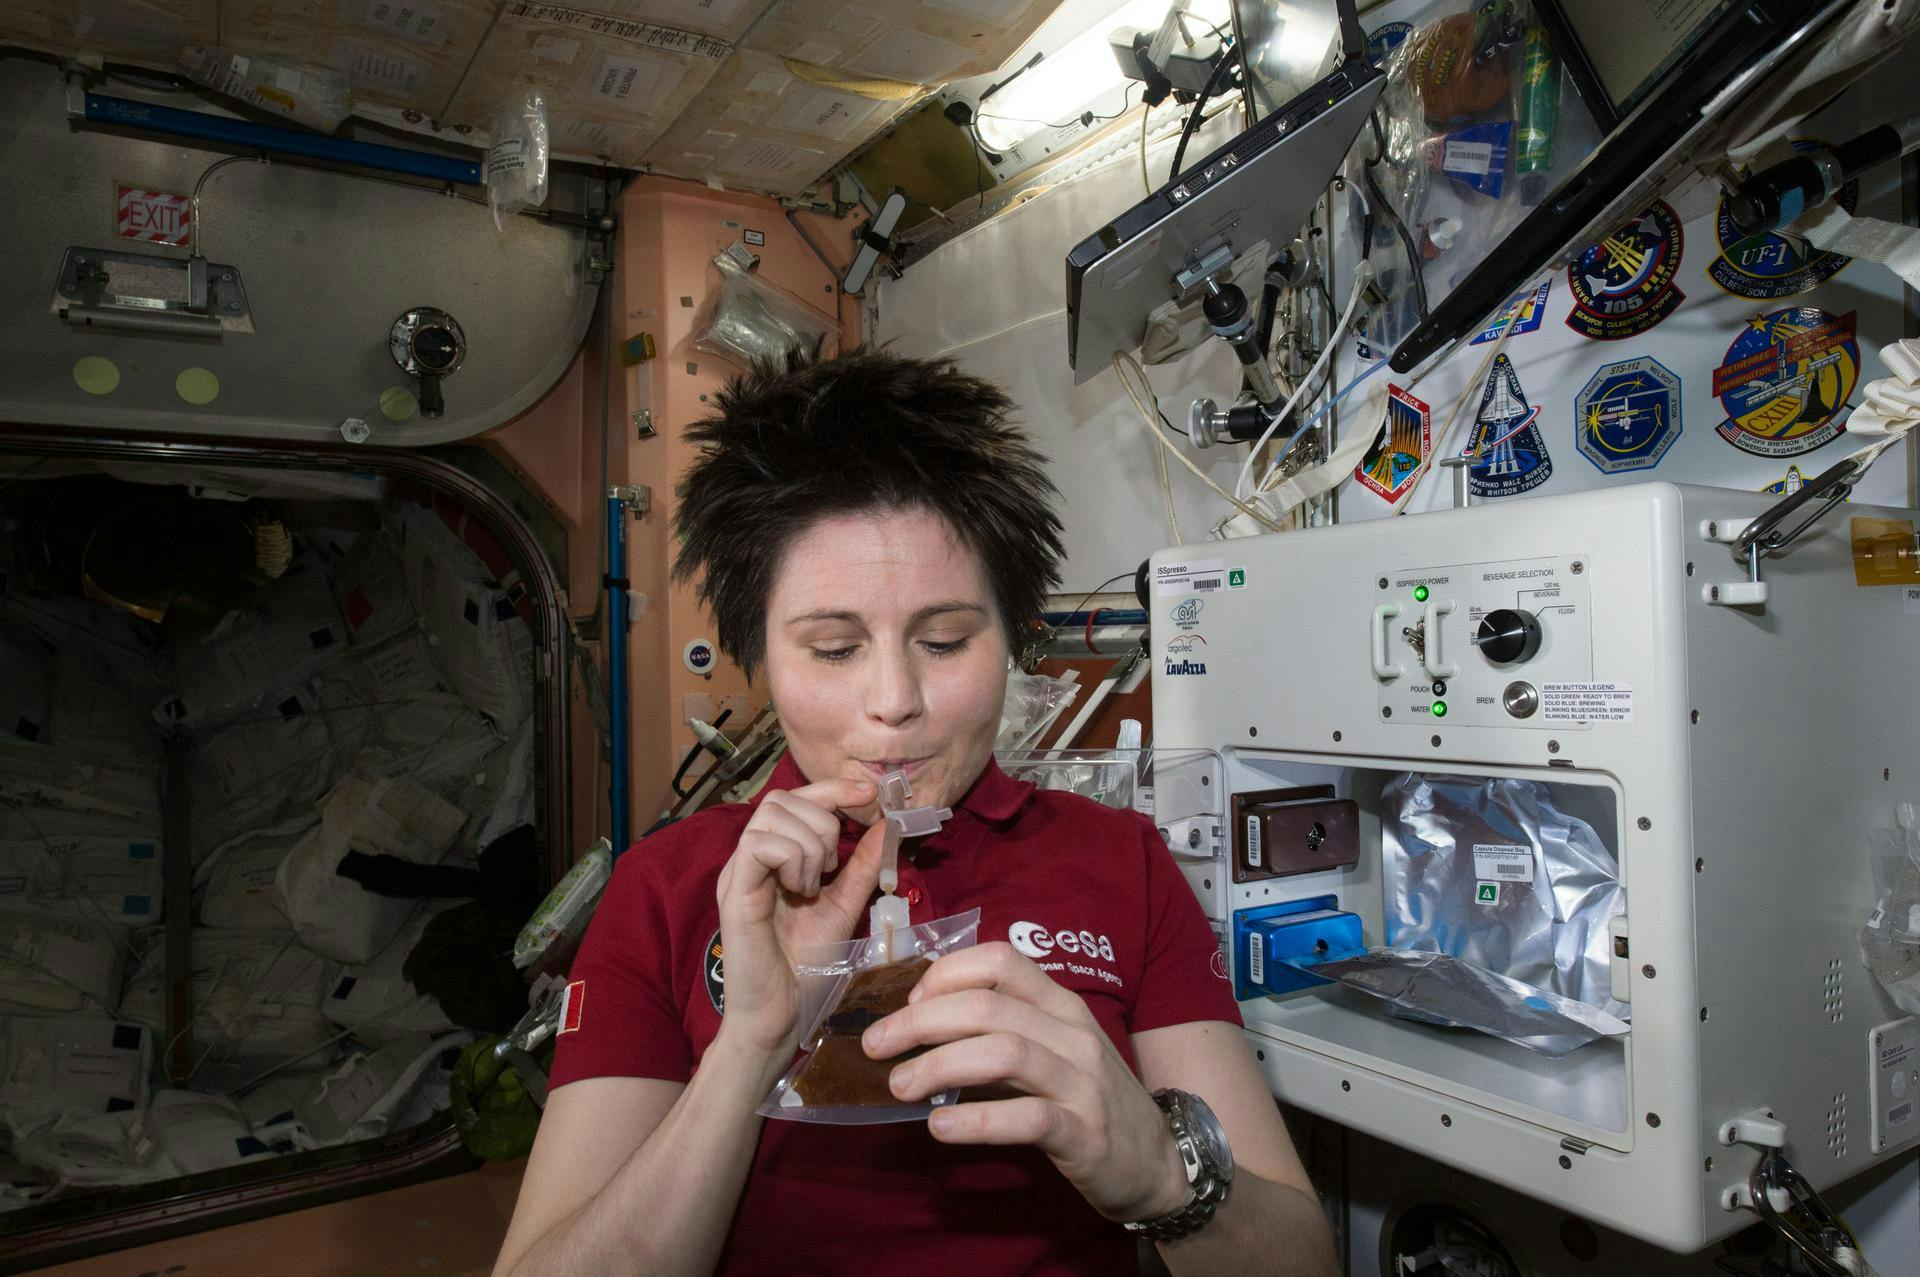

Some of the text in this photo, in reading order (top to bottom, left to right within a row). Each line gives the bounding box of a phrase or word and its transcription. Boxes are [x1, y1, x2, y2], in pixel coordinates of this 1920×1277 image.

[1368, 24, 1405, 43] TURCKOW
[130, 200, 178, 232] EXIT
[1659, 223, 1679, 286] FORRESTER
[1741, 242, 1788, 267] UF-1
[1536, 282, 1550, 305] REIL
[1572, 275, 1590, 303] BARRY
[1714, 270, 1768, 298] CULBERTSON
[1603, 295, 1645, 314] 105
[1610, 361, 1641, 375] STS-112
[1720, 350, 1771, 376] WETHERBEE
[1484, 364, 1500, 401] COCKRELL
[1503, 361, 1522, 396] LOCKHART
[1649, 366, 1674, 386] MELROY
[1719, 365, 1772, 391] HERRINGTON
[1584, 376, 1604, 398] ASHBY
[1399, 391, 1420, 409] FRICK
[1670, 398, 1679, 420] WOLF
[1468, 423, 1481, 448] PERRIN
[1651, 430, 1676, 460] SELLERS
[1737, 430, 1833, 454] BOWERSOX БУДАРИН PETTIT
[1583, 444, 1607, 467] MAGNUS
[1611, 458, 1646, 470] ЮРЧИХИН
[1487, 460, 1522, 476] 111
[1524, 460, 1550, 481] BURSCH
[1363, 476, 1385, 495] OCHOA
[1487, 487, 1518, 497] WHITSON
[1502, 478, 1522, 488] WALZ
[1157, 565, 1187, 575] ISSpresso
[1483, 568, 1554, 581] BEVERAGE SELECTION
[1396, 576, 1449, 588] ISSPRESSO POWER
[1533, 590, 1560, 598] BEVERAGE
[691, 652, 710, 661] NASA
[1167, 643, 1192, 655] argotec
[1166, 660, 1207, 675] LAVAZZA
[1066, 961, 1096, 977] Space
[1097, 968, 1122, 988] Agency
